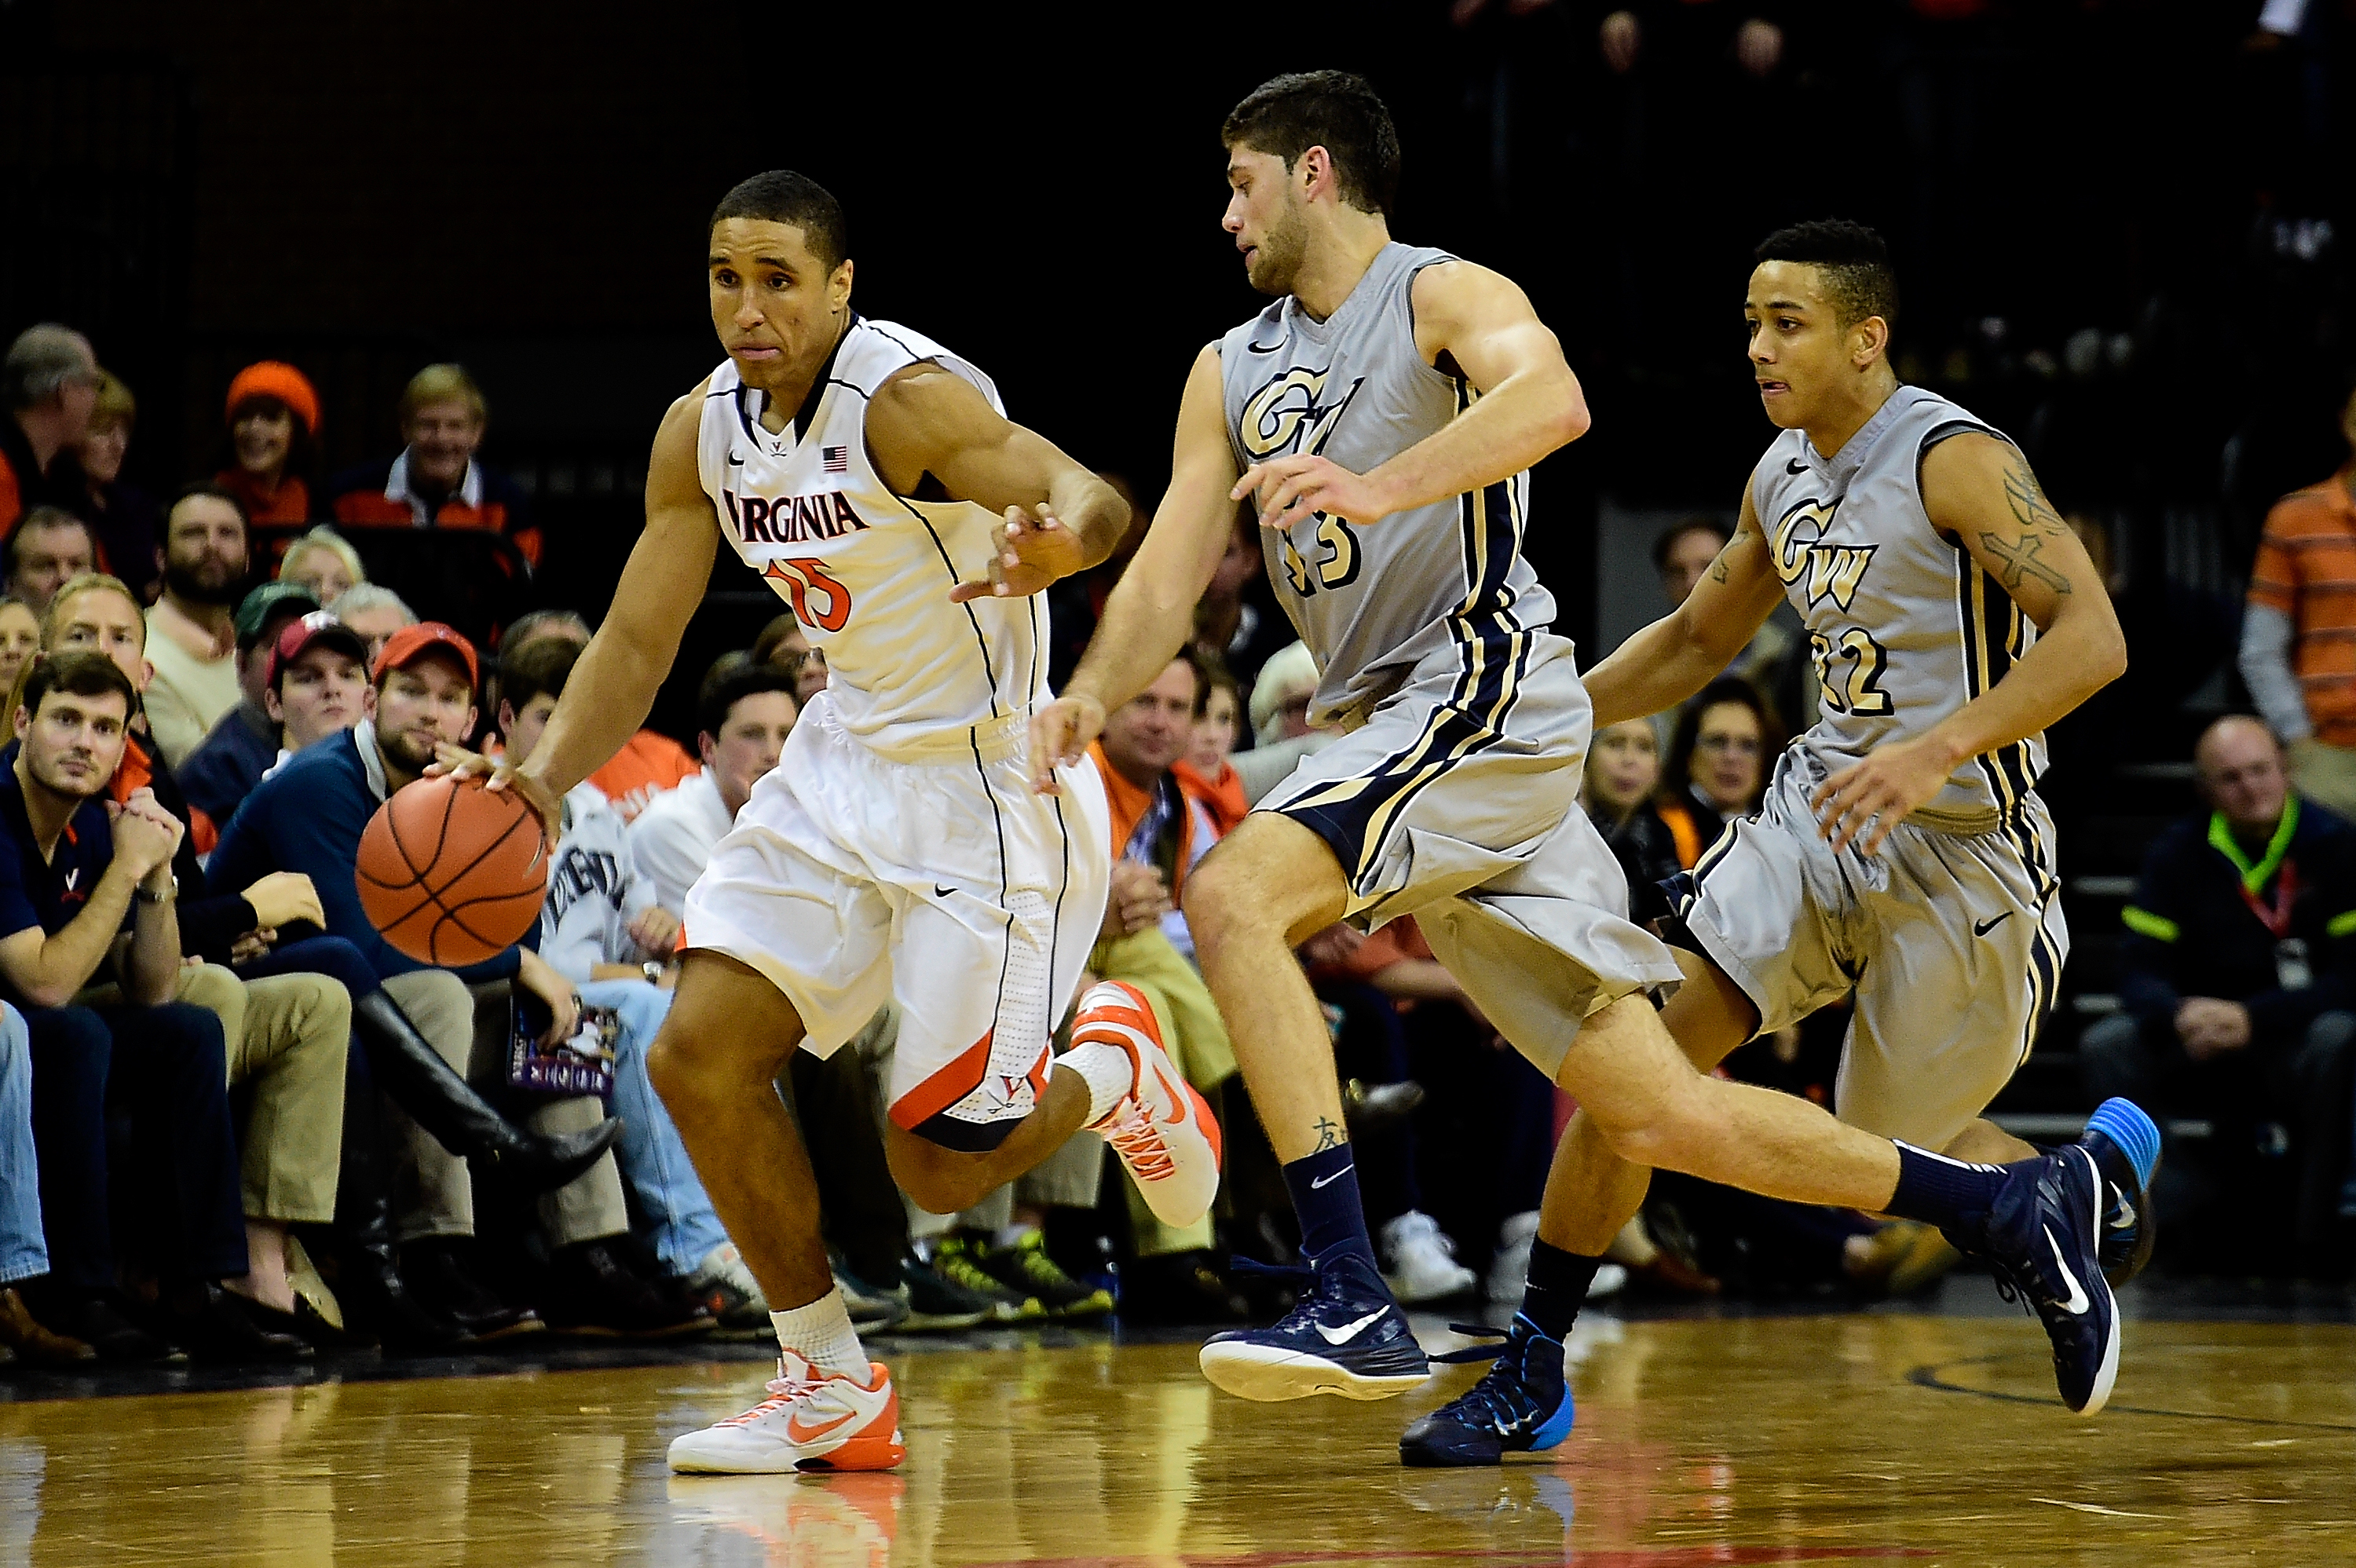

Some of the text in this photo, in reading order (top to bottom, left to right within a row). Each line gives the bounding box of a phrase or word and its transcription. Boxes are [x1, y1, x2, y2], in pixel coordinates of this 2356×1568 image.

[723, 488, 872, 544] VRGINIA
[1772, 497, 1879, 613] GW
[761, 557, 853, 633] 15
